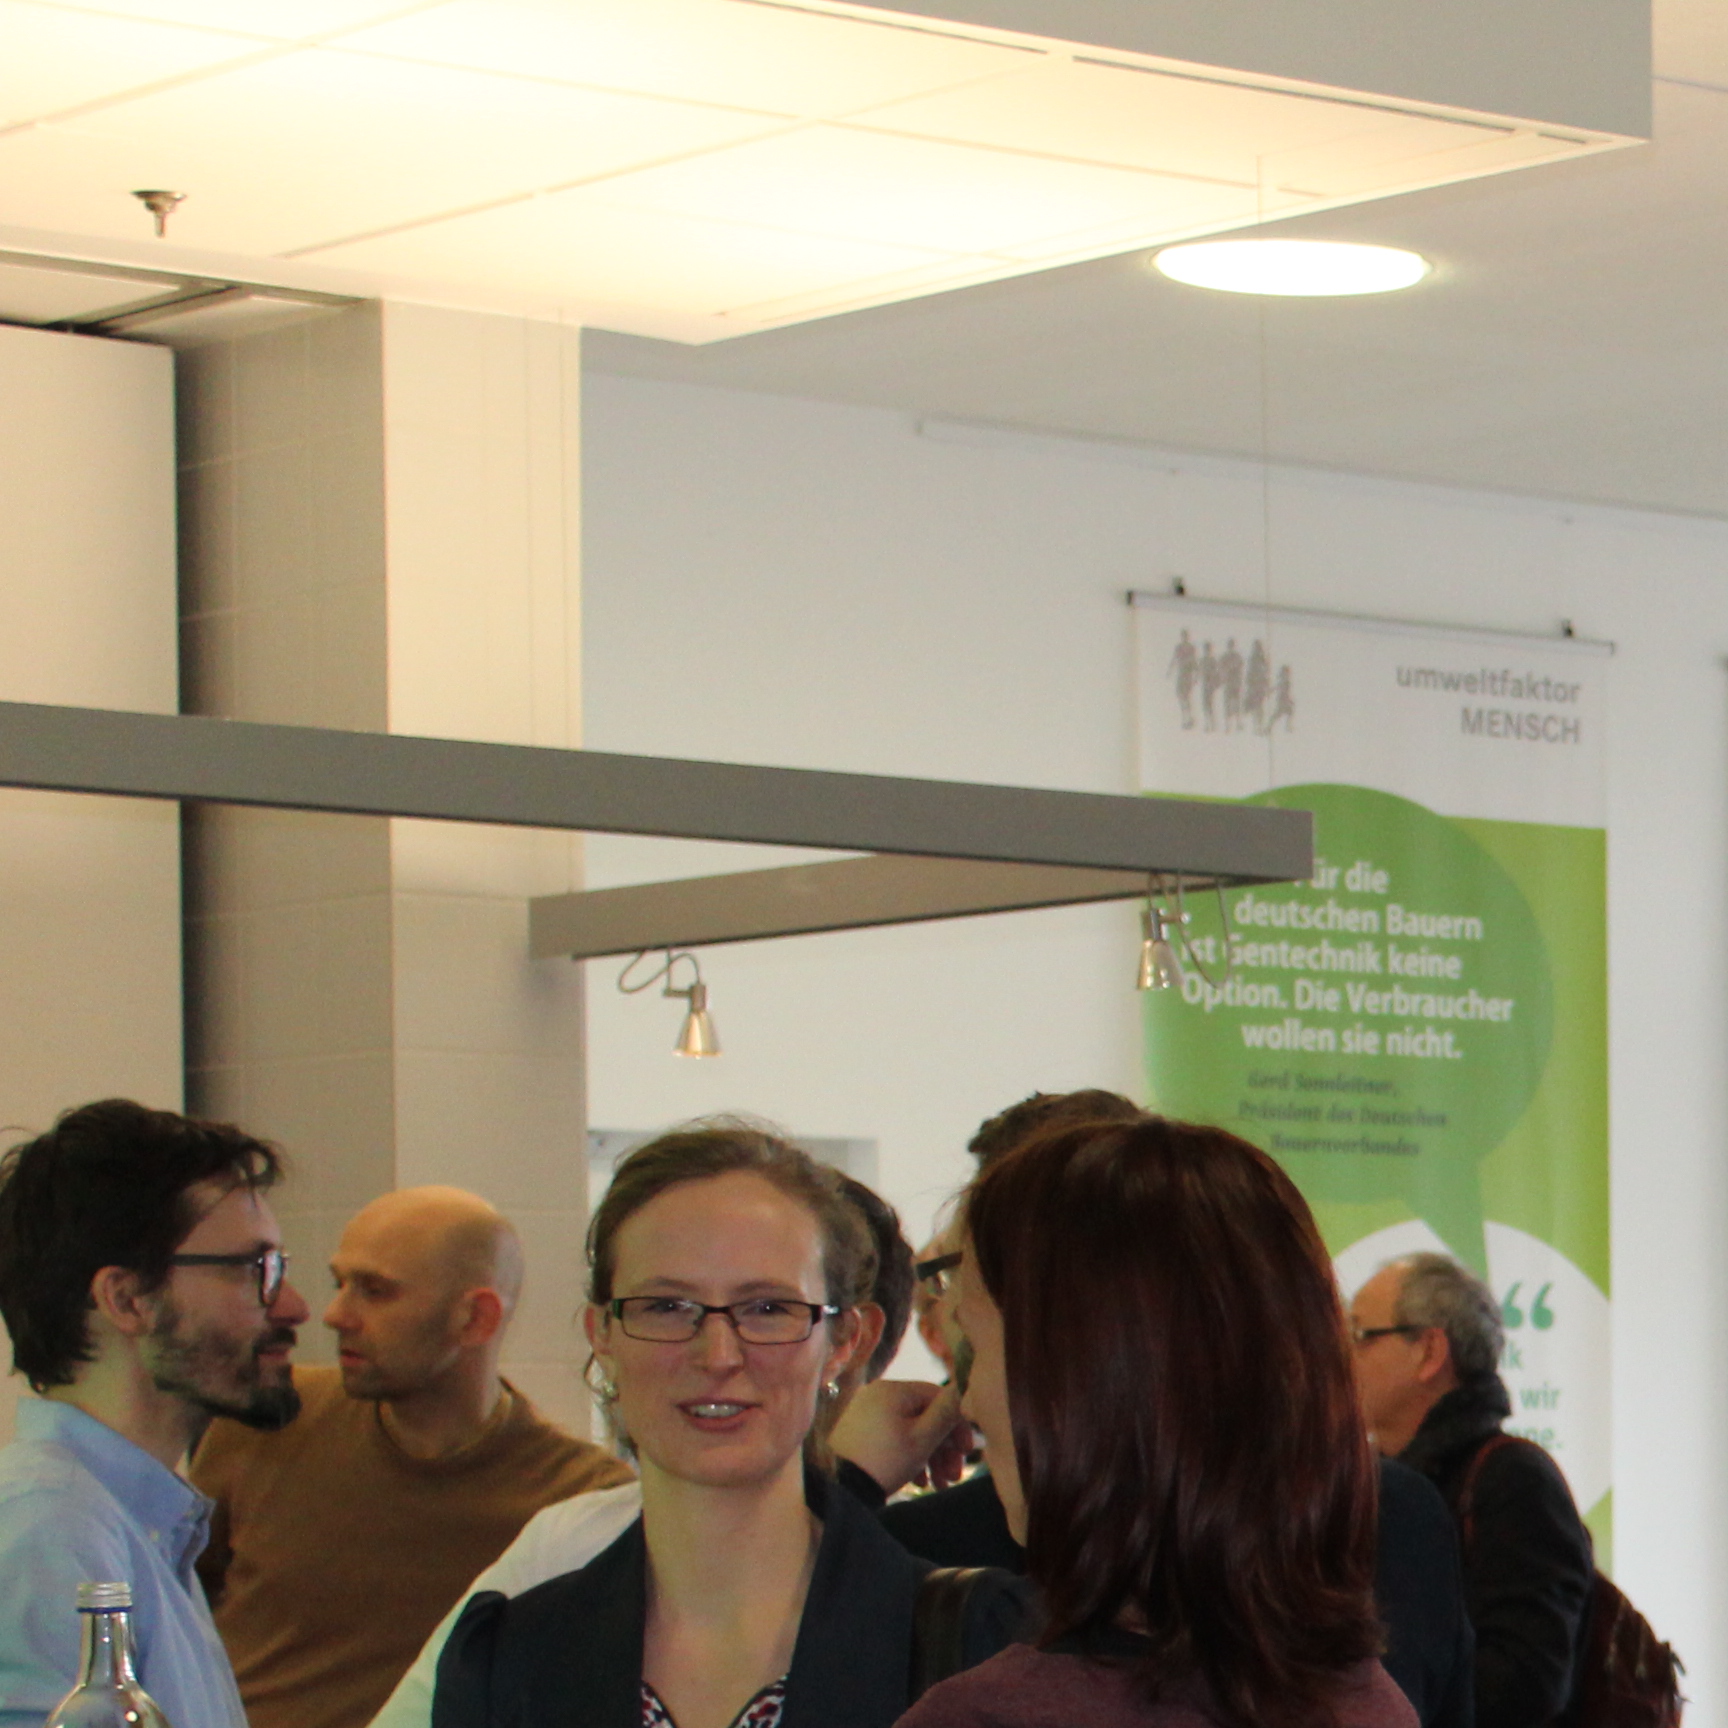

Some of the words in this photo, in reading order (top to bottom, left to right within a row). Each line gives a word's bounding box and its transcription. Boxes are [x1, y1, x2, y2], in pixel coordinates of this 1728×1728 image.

[1396, 666, 1580, 702] umweltfaktor
[1461, 706, 1580, 744] MENSCH
[1345, 860, 1390, 893] die
[1234, 895, 1380, 932] deutschen
[1387, 904, 1484, 940] Bauern
[1224, 934, 1382, 974] Gentechnik
[1388, 944, 1463, 979] keine
[1182, 971, 1289, 1012] Option.
[1294, 978, 1340, 1012] Die
[1346, 983, 1513, 1022] Verbraucher
[1241, 1018, 1336, 1051] wollen
[1342, 1023, 1380, 1055] sie
[1387, 1026, 1464, 1059] nicht.
[1520, 1380, 1561, 1410] wir
